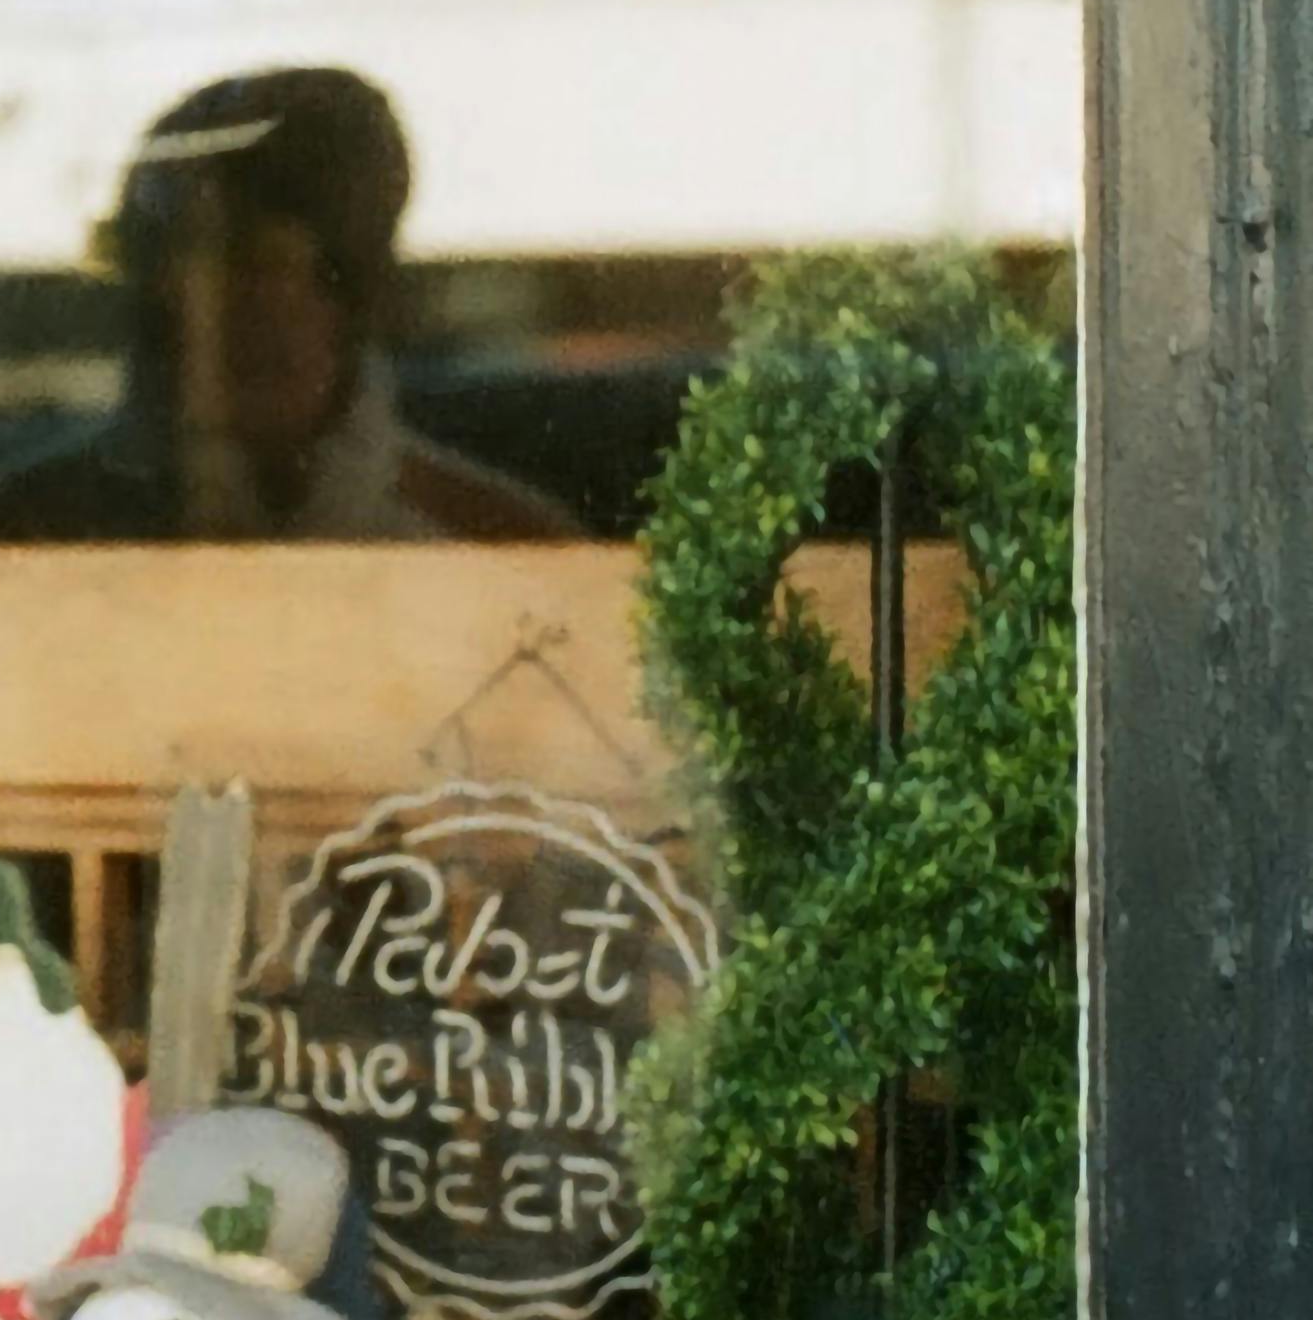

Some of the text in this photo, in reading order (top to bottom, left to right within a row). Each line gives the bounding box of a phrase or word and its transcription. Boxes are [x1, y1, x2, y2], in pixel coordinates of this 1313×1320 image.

[336, 853, 634, 1005] Pabst
[228, 1000, 417, 1118] Blue
[373, 1137, 620, 1240] BEER
